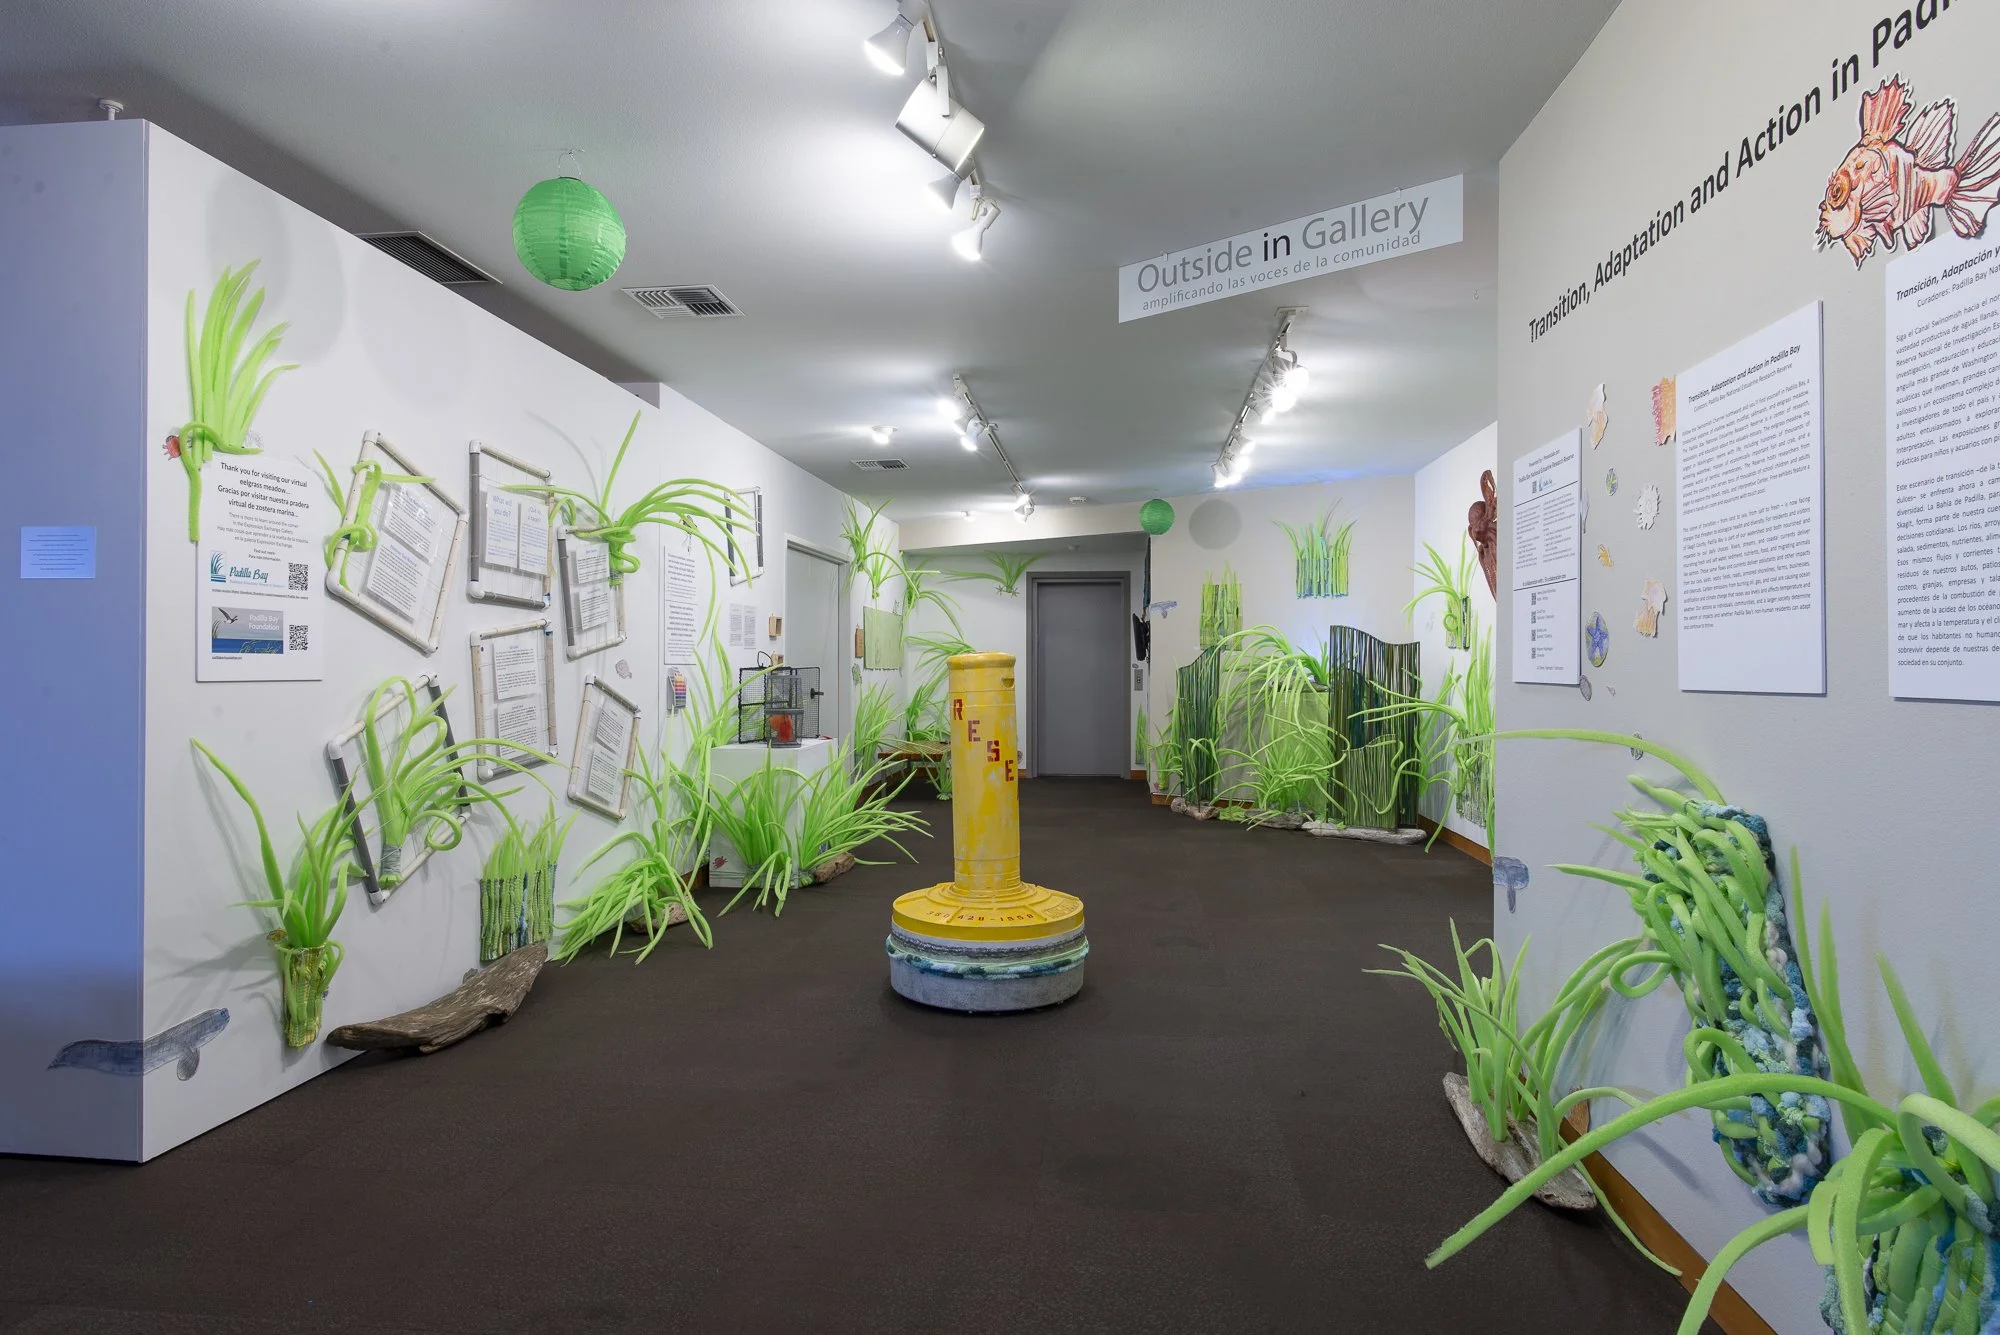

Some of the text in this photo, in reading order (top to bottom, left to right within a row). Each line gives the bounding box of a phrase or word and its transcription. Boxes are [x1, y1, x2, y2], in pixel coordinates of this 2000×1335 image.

[1528, 282, 1591, 343] Transition,
[1593, 200, 1684, 287] Adaptation
[1690, 151, 1729, 214] and
[1736, 87, 1821, 179] Action
[1832, 54, 1859, 102] in
[1138, 197, 1429, 292] Outside in Gallery
[1142, 230, 1421, 310] amplificando las voces de la comunidad
[1897, 245, 2000, 300] Transición, Adaptación y
[1952, 277, 1973, 291] Padilla
[1975, 271, 1987, 281] Bay
[1896, 334, 1906, 342] Siga
[1914, 322, 1929, 334] Canal
[1964, 303, 1979, 313] hacia
[1961, 317, 1978, 329] aguas
[1980, 309, 1999, 320] llanas,
[1918, 343, 1942, 358] Nacional
[1952, 326, 1991, 345] Investigación
[1934, 348, 1969, 365] restauración
[1710, 376, 1736, 392] Adaptation
[1737, 369, 1746, 380] and
[1747, 363, 1763, 375] Action
[1770, 350, 1788, 364] Padilla
[1789, 345, 1800, 355] Bay
[1930, 368, 1949, 381] grande
[1961, 352, 1997, 368] Washington
[1921, 370, 1986, 396] que grandes
[1932, 390, 1964, 405] ecosistema
[1965, 381, 1993, 394] complejo
[1952, 403, 1966, 412] todo
[1952, 424, 1990, 439] exposiciones
[1920, 452, 1932, 462] para
[1955, 440, 1980, 451] acuarios
[221, 462, 238, 472] Thank
[261, 472, 280, 483] visiting
[290, 479, 307, 487] virtual
[239, 479, 262, 488] eelgrass
[1908, 478, 1935, 488] escenario
[1945, 469, 1974, 480] transición
[217, 485, 239, 495] Gracias
[251, 492, 268, 500] visitar
[268, 496, 288, 504] nuestra
[1930, 487, 1954, 497] enfrenta
[1958, 482, 1975, 491] ahora
[1964, 493, 1985, 503] Padilla,
[228, 499, 246, 507] virtual
[255, 505, 275, 513] zostera
[1934, 514, 1950, 523] parte
[1962, 508, 1984, 517] nuestra
[1952, 536, 1983, 545] nutrientes,
[1962, 548, 1993, 557] corrientes
[230, 566, 269, 583] Padilla Bay
[1922, 578, 1976, 590] granjas, empresas
[1950, 590, 1984, 599] combustión
